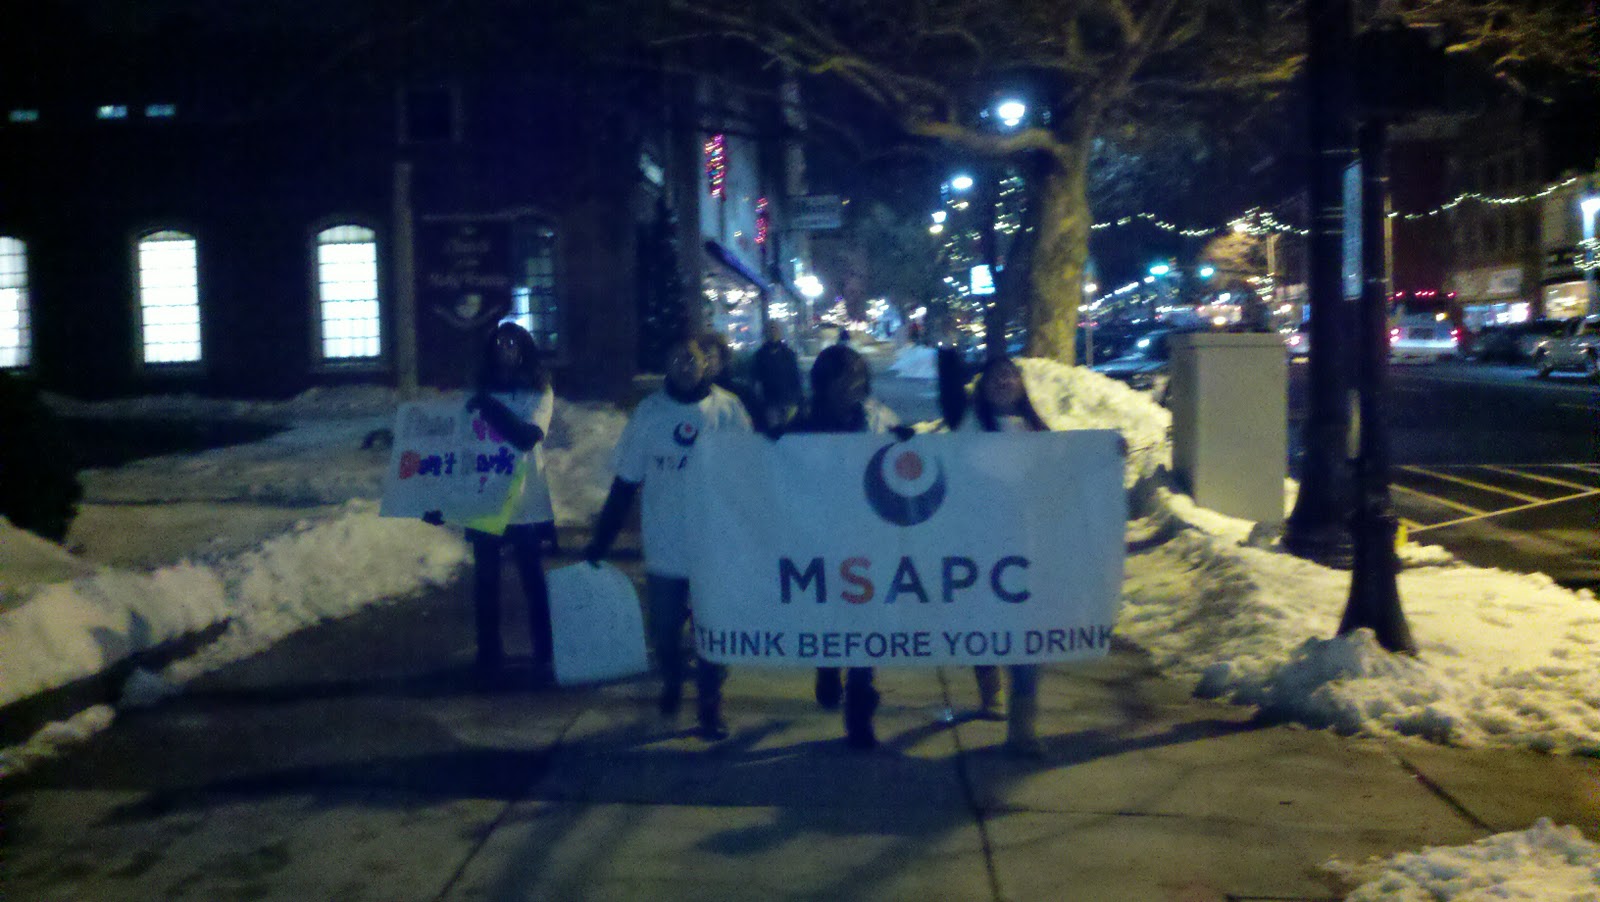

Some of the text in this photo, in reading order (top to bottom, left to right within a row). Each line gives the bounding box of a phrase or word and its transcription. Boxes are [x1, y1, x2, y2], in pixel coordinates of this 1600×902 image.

[778, 555, 1032, 604] MSAPC
[697, 623, 1112, 658] THINK BEFORE YOU DRINK
